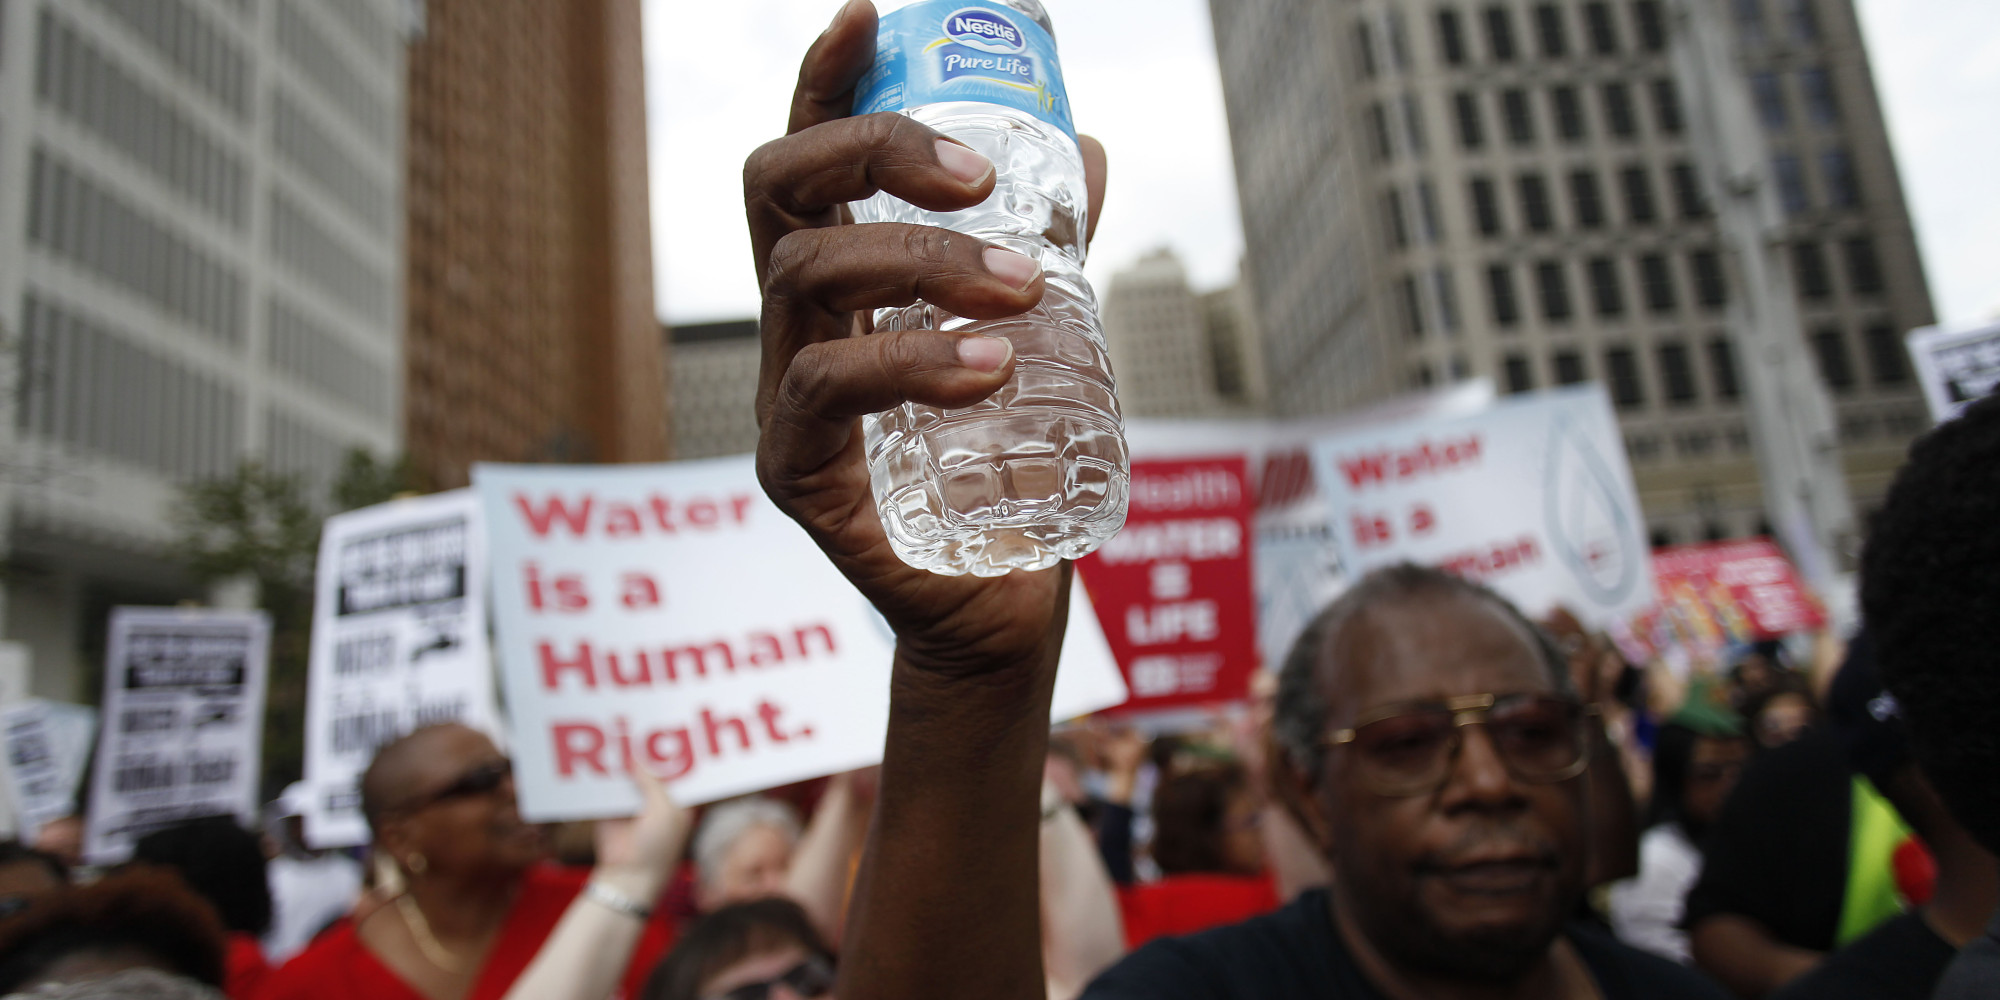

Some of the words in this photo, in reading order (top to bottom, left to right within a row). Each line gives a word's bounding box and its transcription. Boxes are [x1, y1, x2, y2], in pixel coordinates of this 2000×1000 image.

[955, 17, 1016, 42] Nestlé
[944, 54, 995, 72] Pure
[996, 57, 1030, 76] Life
[1338, 433, 1482, 489] Water
[513, 493, 754, 541] Water
[1352, 507, 1393, 547] is
[523, 560, 591, 614] is
[619, 572, 662, 610] a
[1124, 600, 1218, 647] LIFE
[536, 620, 838, 692] Human
[550, 697, 815, 783] Right.
